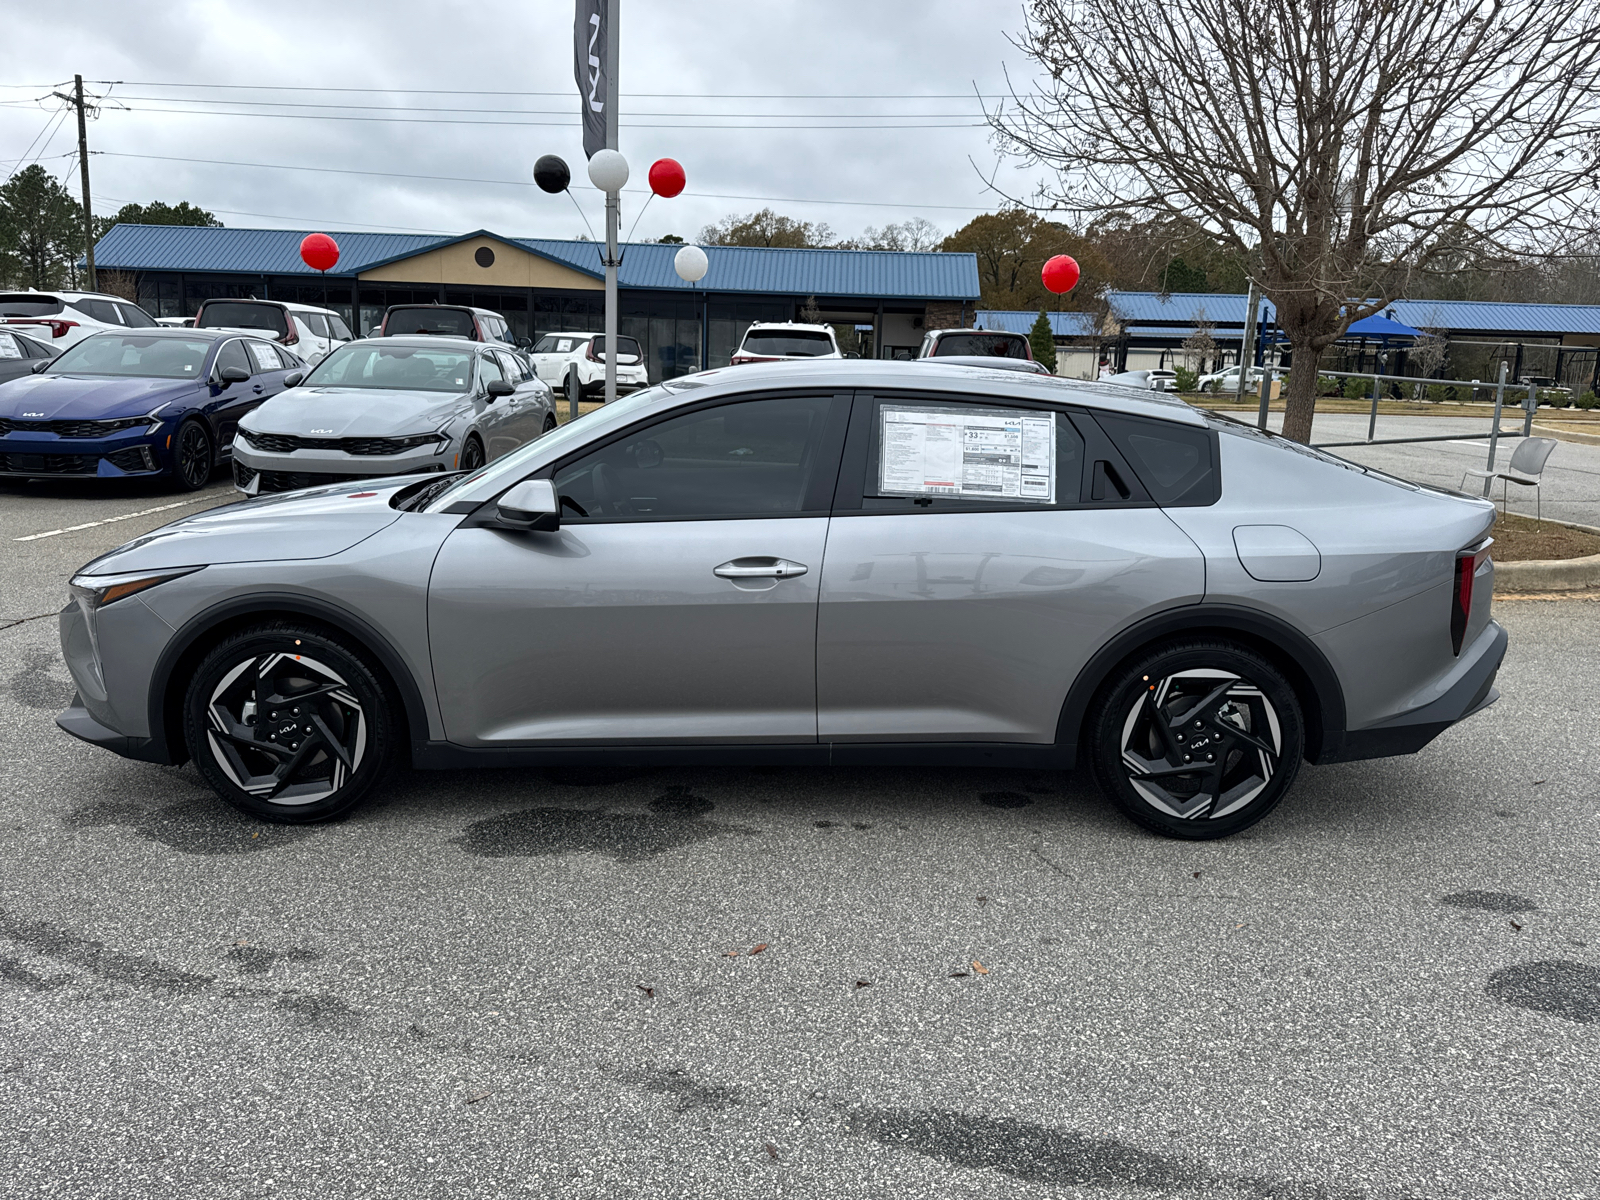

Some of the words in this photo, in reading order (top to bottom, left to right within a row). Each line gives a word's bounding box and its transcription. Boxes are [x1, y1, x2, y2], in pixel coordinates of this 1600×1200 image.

[968, 431, 978, 439] 33
[279, 723, 297, 734] KIA
[1190, 738, 1209, 749] KIA
[203, 767, 242, 806] KUMHO
